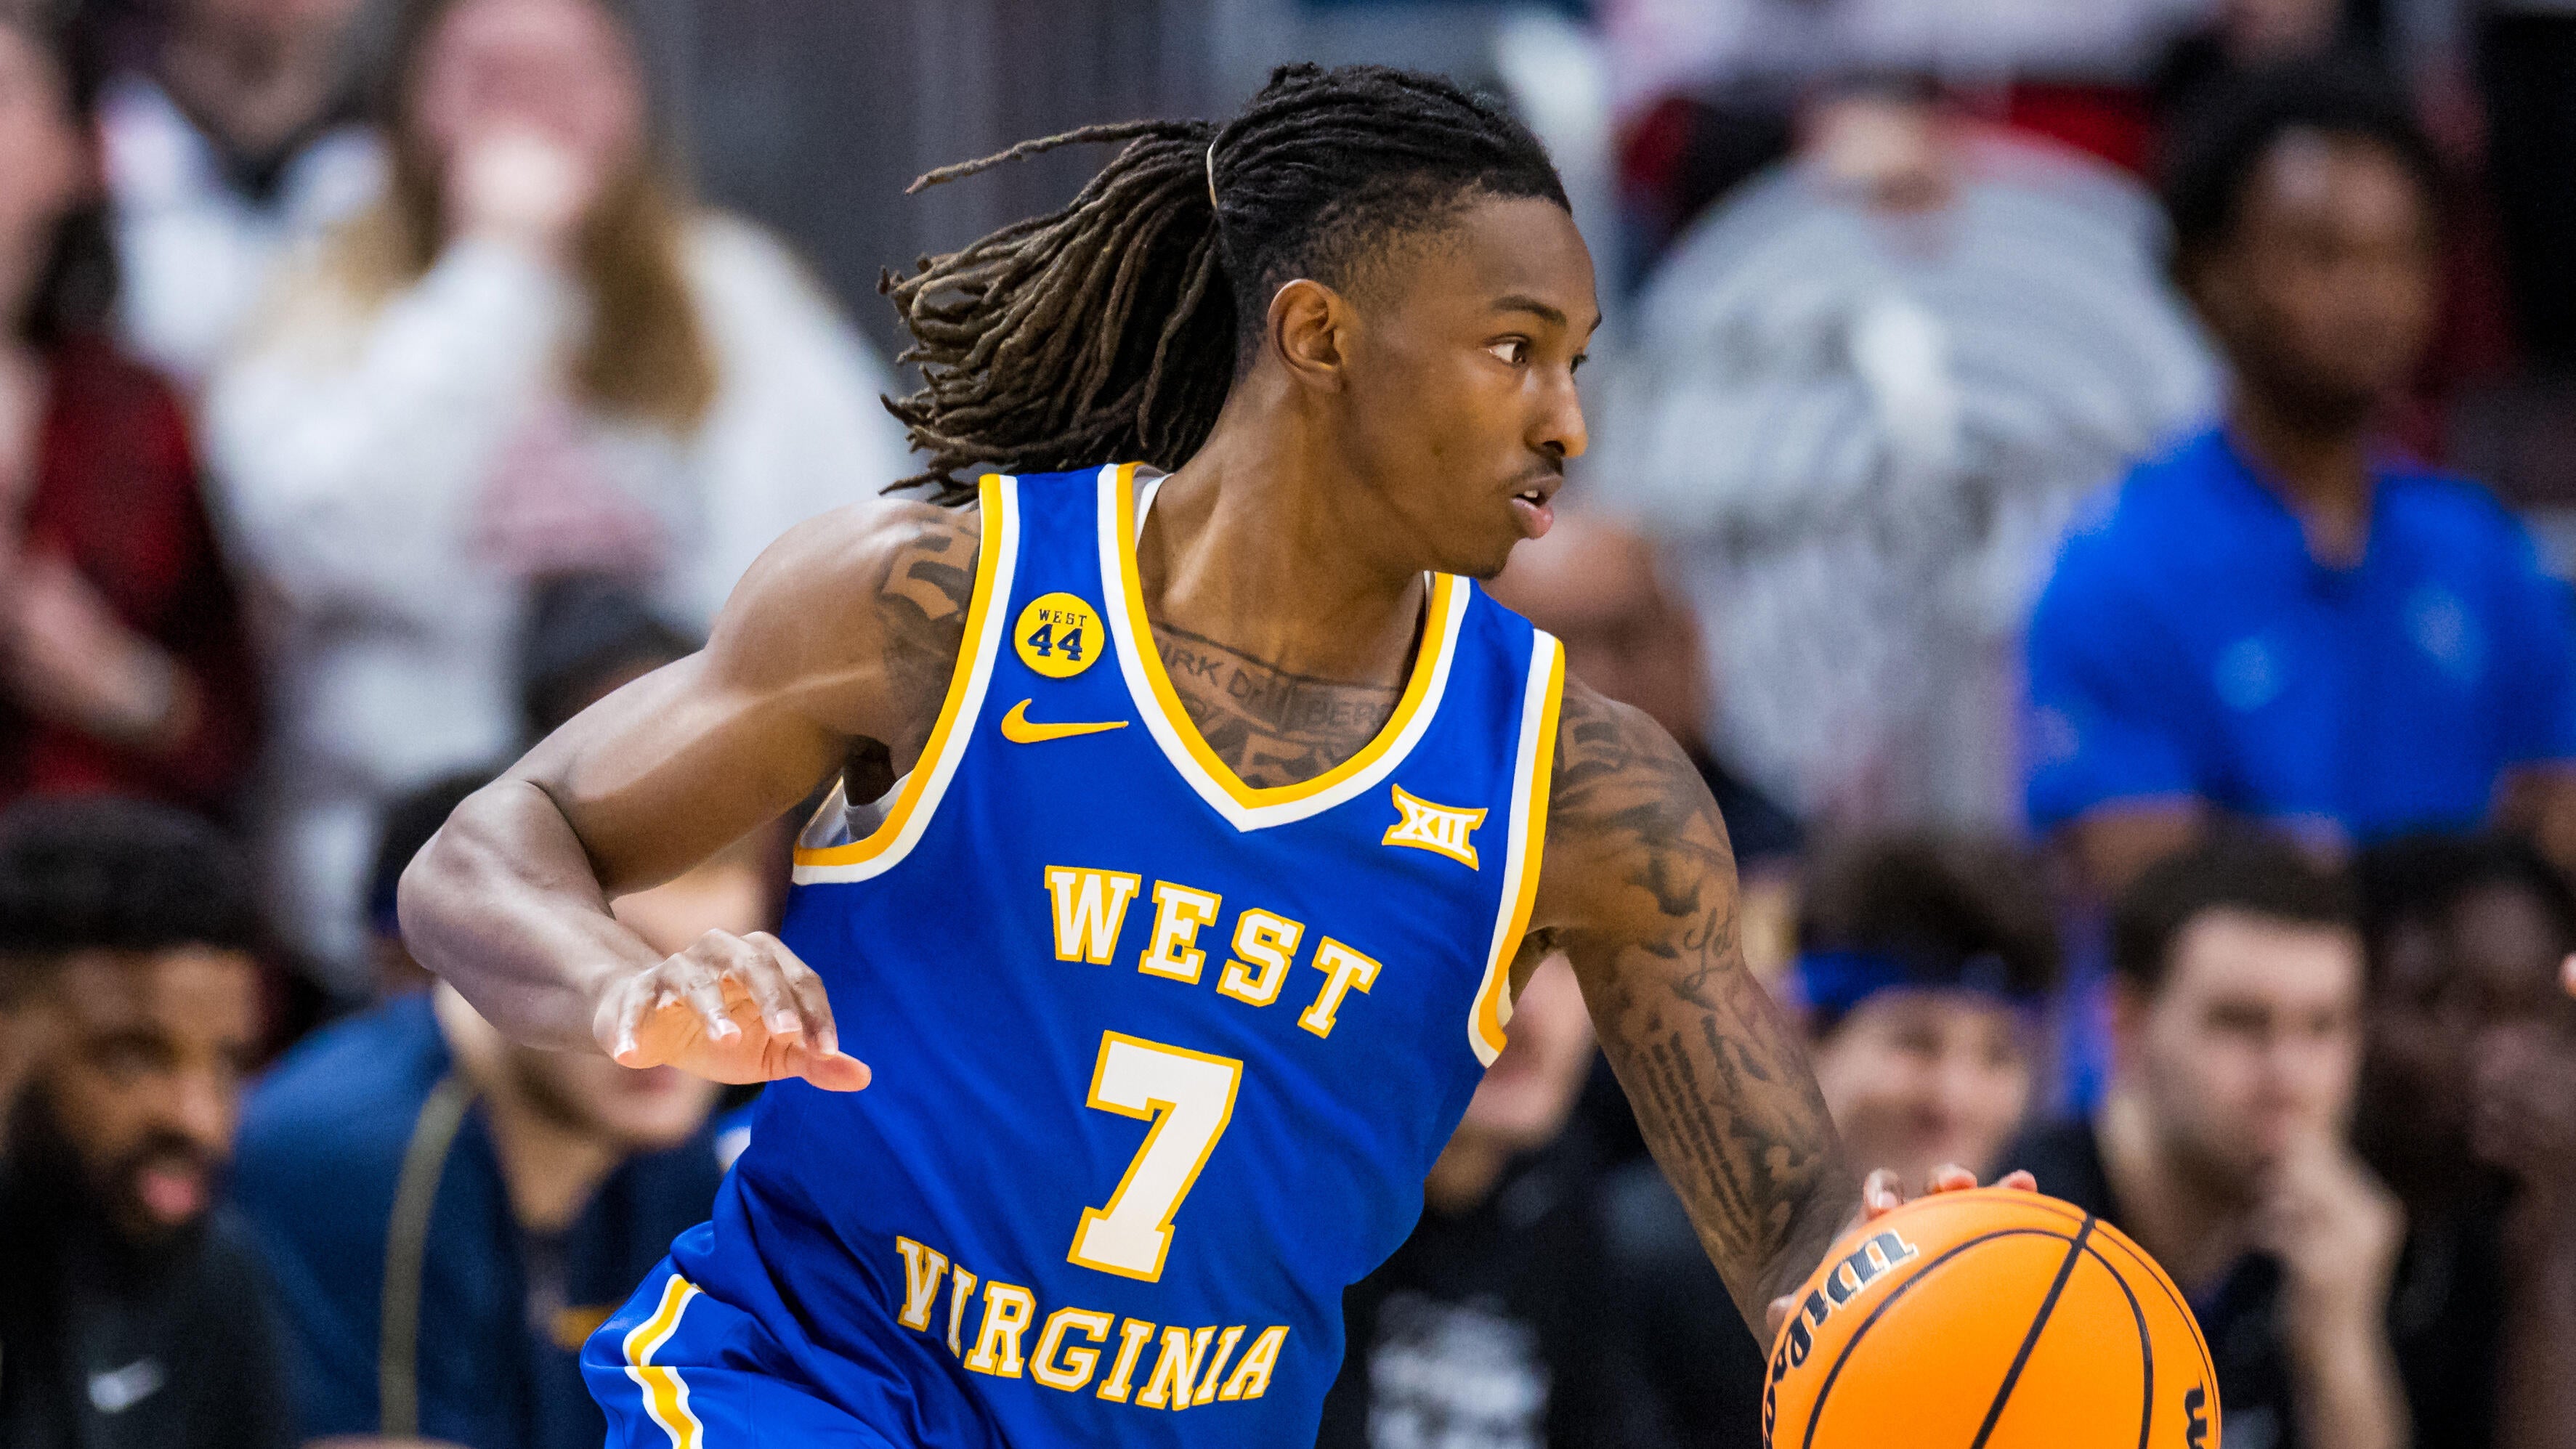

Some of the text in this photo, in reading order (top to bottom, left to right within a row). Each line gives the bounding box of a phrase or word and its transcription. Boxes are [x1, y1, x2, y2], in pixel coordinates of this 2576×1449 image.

[1027, 623, 1083, 662] 44
[1039, 609, 1087, 627] WEST
[1382, 783, 1489, 872] XII
[1044, 865, 1382, 1039] WEST
[1066, 1029, 1244, 1283] 7
[896, 1235, 1289, 1411] VIRGINIA
[1762, 1227, 1920, 1449] Wilso
